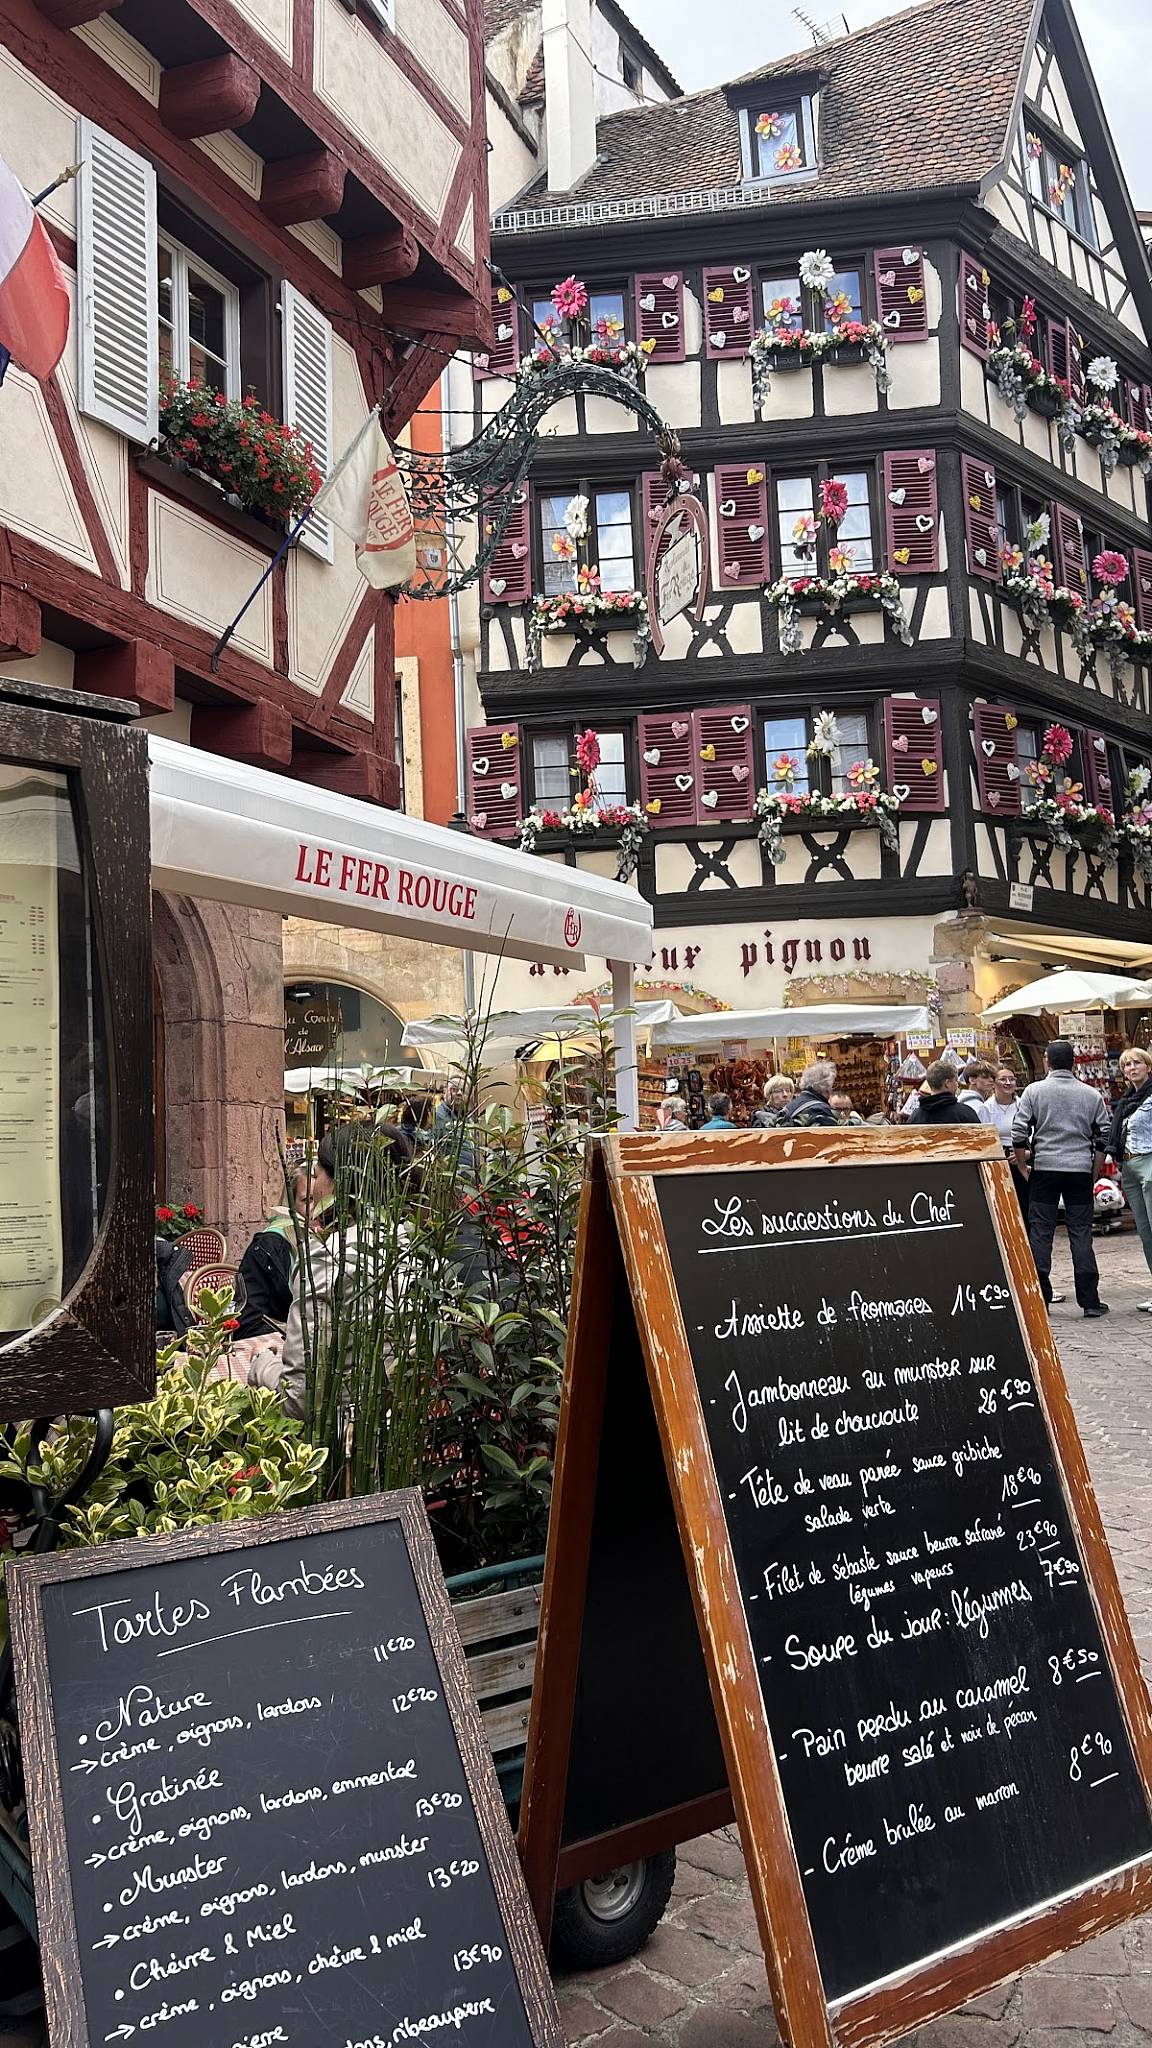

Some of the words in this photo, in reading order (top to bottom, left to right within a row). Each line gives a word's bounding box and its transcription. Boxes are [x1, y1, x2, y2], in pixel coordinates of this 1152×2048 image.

[295, 845, 333, 887] LE
[339, 855, 390, 901] FER
[398, 870, 478, 920] ROUGE
[740, 930, 872, 978] pignon
[297, 1027, 309, 1036] de
[701, 1195, 754, 1237] Les
[882, 1199, 905, 1227] du
[910, 1189, 956, 1225] Chef
[714, 1299, 805, 1339] Assiette
[816, 1297, 838, 1325] de
[724, 1369, 851, 1434] Jambonneau
[861, 1369, 887, 1390] au
[778, 1416, 806, 1447] lit
[810, 1412, 830, 1440] de
[739, 1465, 789, 1509] Tête
[793, 1467, 816, 1496] de
[818, 1472, 853, 1491] veau
[859, 1448, 902, 1498] panée
[911, 1454, 947, 1474] sauce
[951, 1435, 1003, 1478] gribiche
[804, 1504, 853, 1533] salade
[861, 1494, 897, 1519] verte
[763, 1561, 805, 1601] Filet
[808, 1560, 826, 1585] de
[831, 1545, 881, 1581] sébaste
[885, 1546, 920, 1566] sauce
[923, 1531, 962, 1555] beurre
[964, 1512, 1006, 1546] safrané
[71, 1590, 211, 1652] Tartes
[220, 1559, 365, 1606] Flambées
[849, 1579, 896, 1612] légumes
[910, 1562, 954, 1590] vapeurs
[866, 1614, 894, 1649] du
[950, 1579, 1033, 1639] légumes
[95, 1684, 213, 1742] Nature
[791, 1728, 847, 1758] Pain
[918, 1698, 948, 1722] au
[843, 1753, 890, 1787] beurre
[901, 1730, 935, 1767] salé
[940, 1726, 955, 1752] et
[960, 1727, 983, 1744] noix
[986, 1712, 1001, 1736] de
[1003, 1700, 1038, 1740] pécan
[105, 1767, 224, 1835] Gratinée
[331, 1758, 418, 1795] emmental
[882, 1803, 936, 1845] brulée
[944, 1806, 966, 1823] au
[975, 1782, 1020, 1811] marron
[359, 1833, 430, 1867] munster
[119, 1853, 228, 1906] Munster
[224, 1932, 239, 1955] &
[246, 1913, 297, 1948] Miel
[369, 1934, 382, 1954] &
[386, 1917, 427, 1948] miel
[453, 1943, 503, 1972] 13€90
